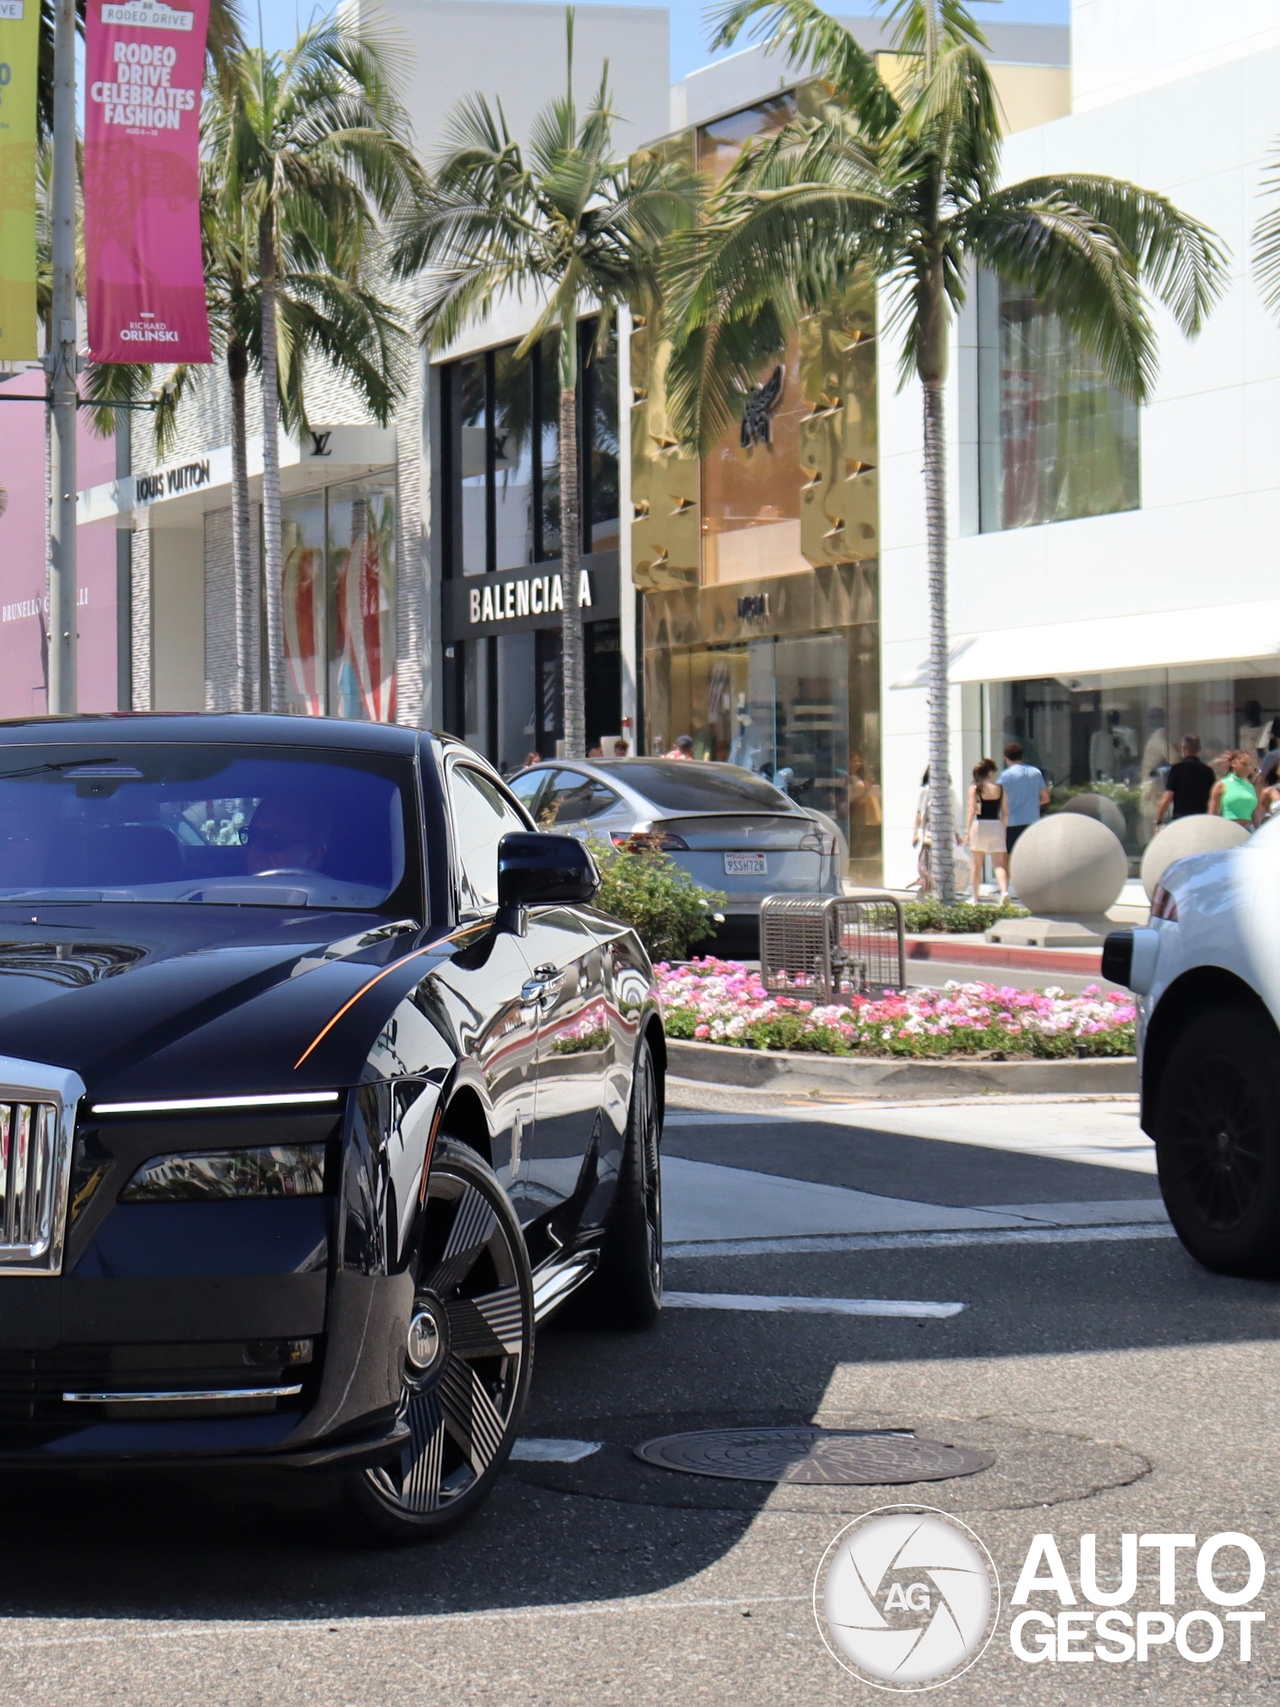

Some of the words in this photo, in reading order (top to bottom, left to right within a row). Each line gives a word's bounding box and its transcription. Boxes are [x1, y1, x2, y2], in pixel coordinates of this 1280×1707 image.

[107, 9, 147, 21] RODEO
[152, 13, 187, 25] DRIVE
[113, 41, 177, 67] RODEO
[117, 63, 172, 87] DRIVE
[91, 81, 195, 110] CELEBRATES
[104, 103, 180, 129] FASHION
[120, 329, 179, 342] ORLINSKI
[129, 321, 166, 330] RICHARD
[310, 431, 332, 456] LV
[136, 472, 164, 501] LOUIS
[166, 459, 210, 493] VUITTON
[470, 569, 592, 624] BALENCIAA
[2, 597, 42, 622] BRUNELLO
